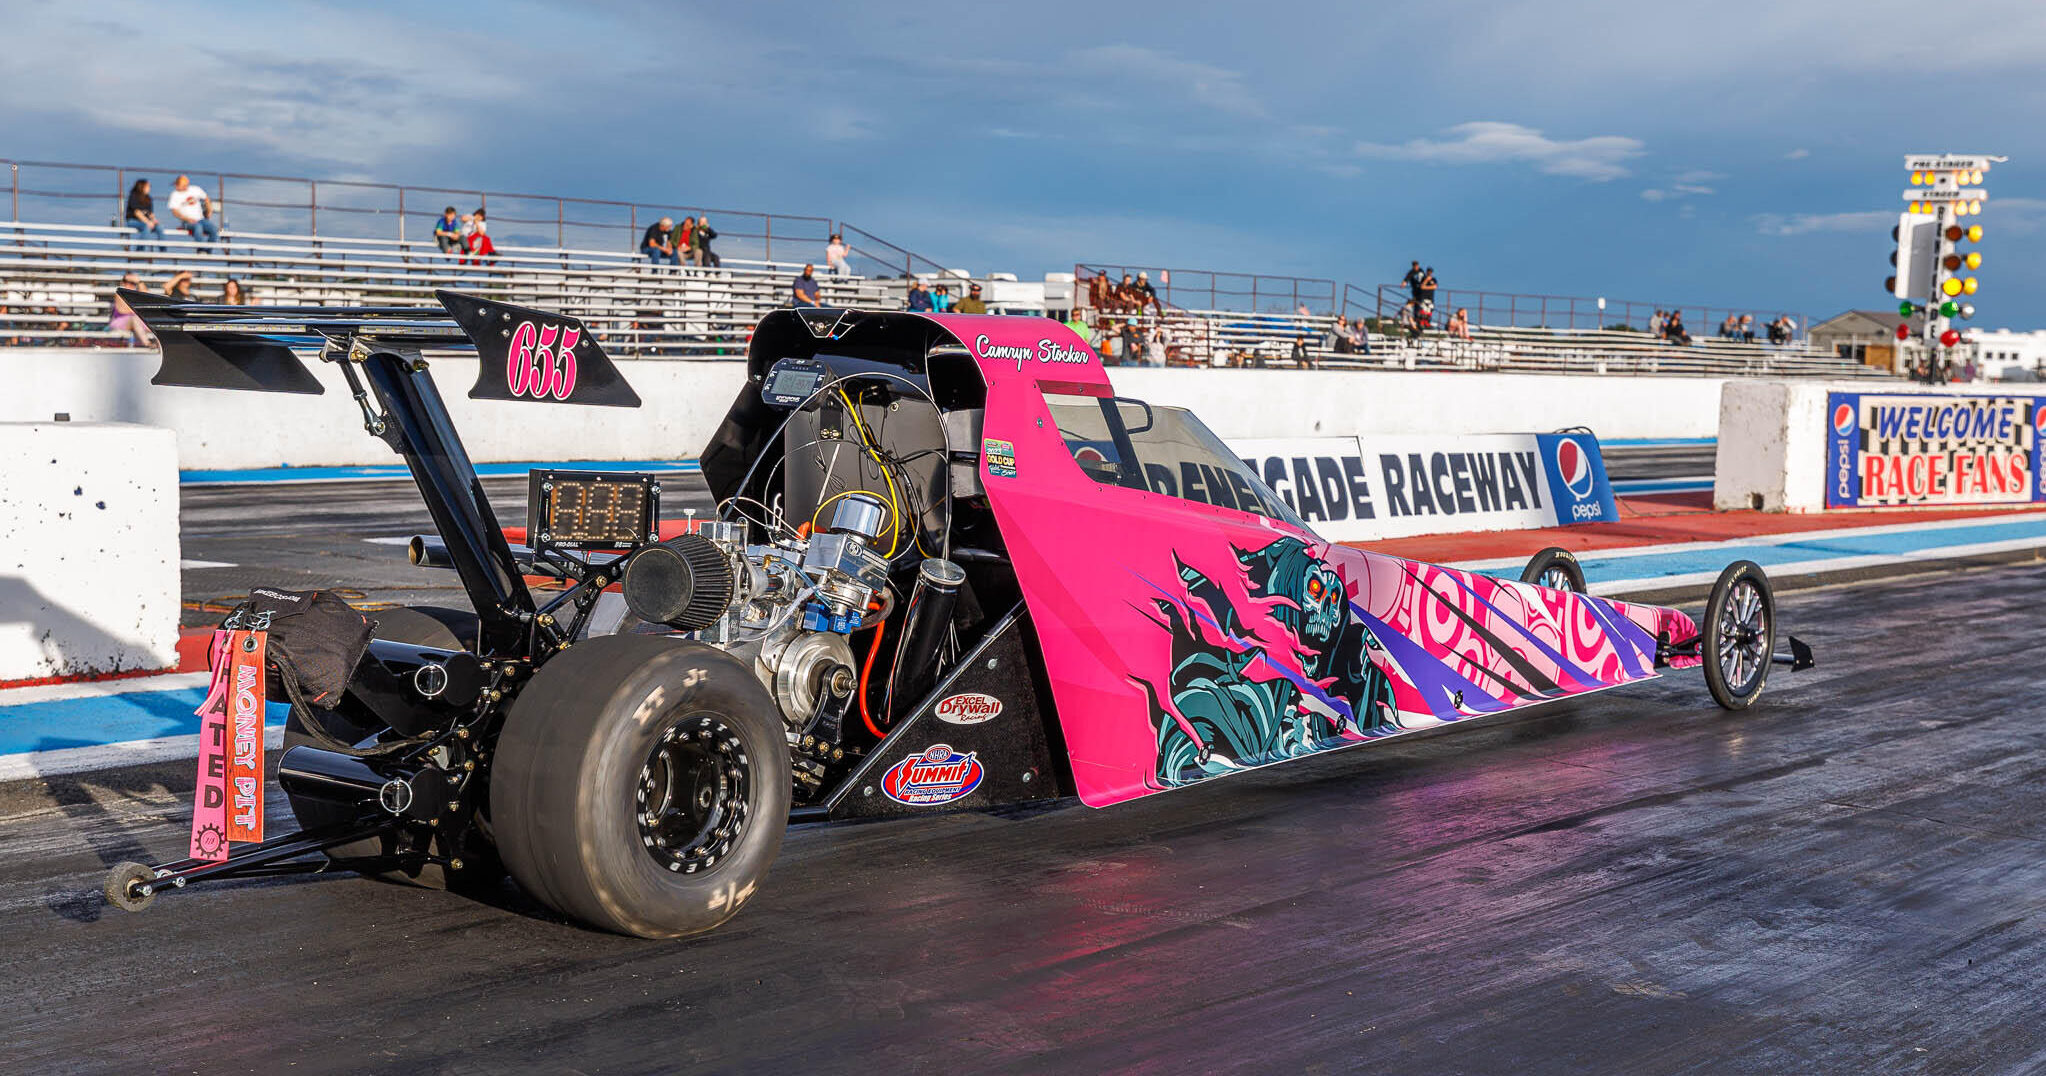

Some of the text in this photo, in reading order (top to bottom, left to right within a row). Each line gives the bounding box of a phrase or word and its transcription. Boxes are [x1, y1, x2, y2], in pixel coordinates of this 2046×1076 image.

[507, 321, 581, 400] 655
[976, 334, 1089, 372] Camryn Stocker
[1879, 405, 2015, 439] WELCOME
[1379, 451, 1542, 517] RACEWAY
[1838, 439, 1852, 498] pepsi
[1864, 453, 2026, 496] RACE FANS
[1572, 500, 1602, 521] pepsi
[940, 700, 1000, 716] Drywall
[955, 696, 987, 705] EXCEL
[234, 665, 257, 830] MONEY PIT
[929, 749, 950, 761] NHRA
